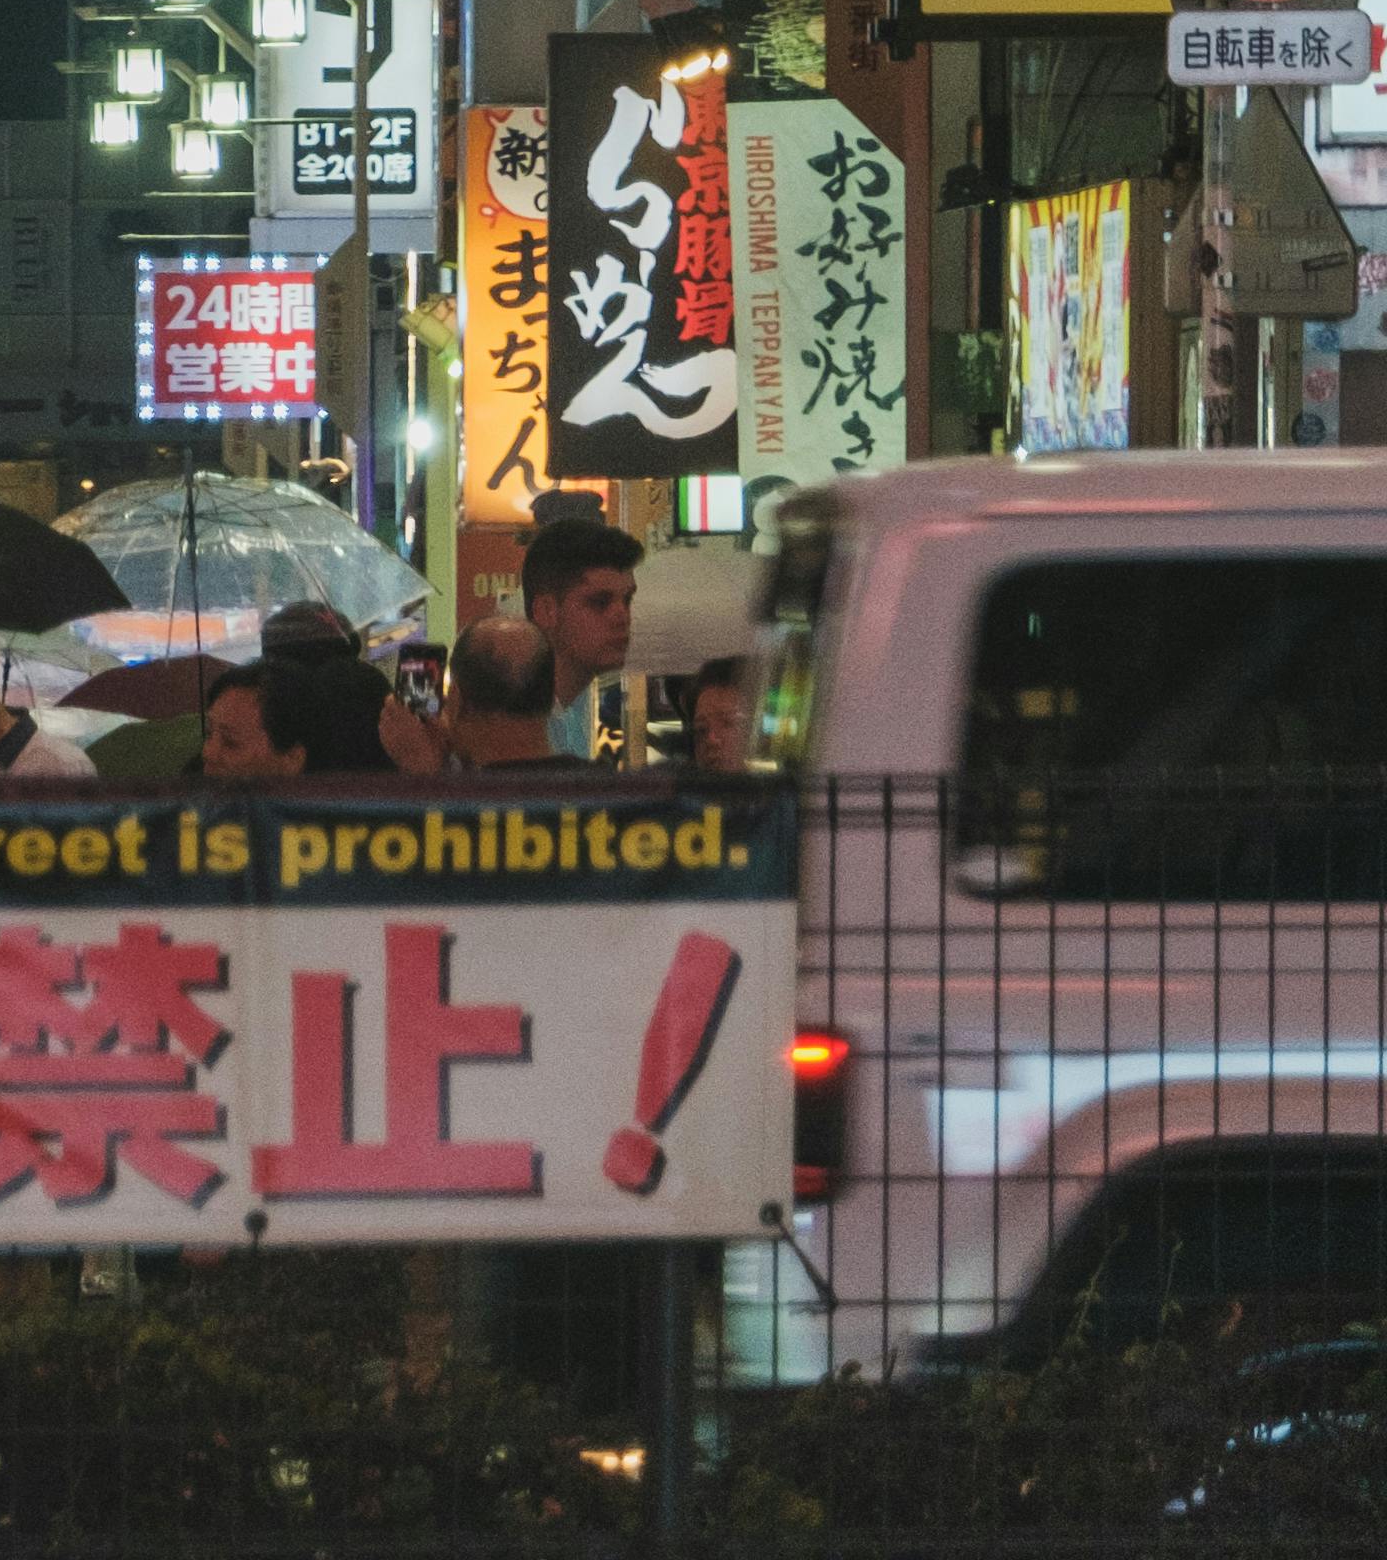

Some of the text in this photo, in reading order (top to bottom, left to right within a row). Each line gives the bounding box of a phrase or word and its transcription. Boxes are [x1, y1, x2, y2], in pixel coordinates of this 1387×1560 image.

[1182, 25, 1356, 72] 自転車を除く
[163, 282, 316, 335] 24時間
[744, 134, 785, 456] HIROSHIMA TEPPANYAKI
[795, 130, 907, 477] お好み焼き
[164, 342, 316, 395] 営業中
[176, 806, 252, 876] is
[280, 804, 750, 888] prohibited.
